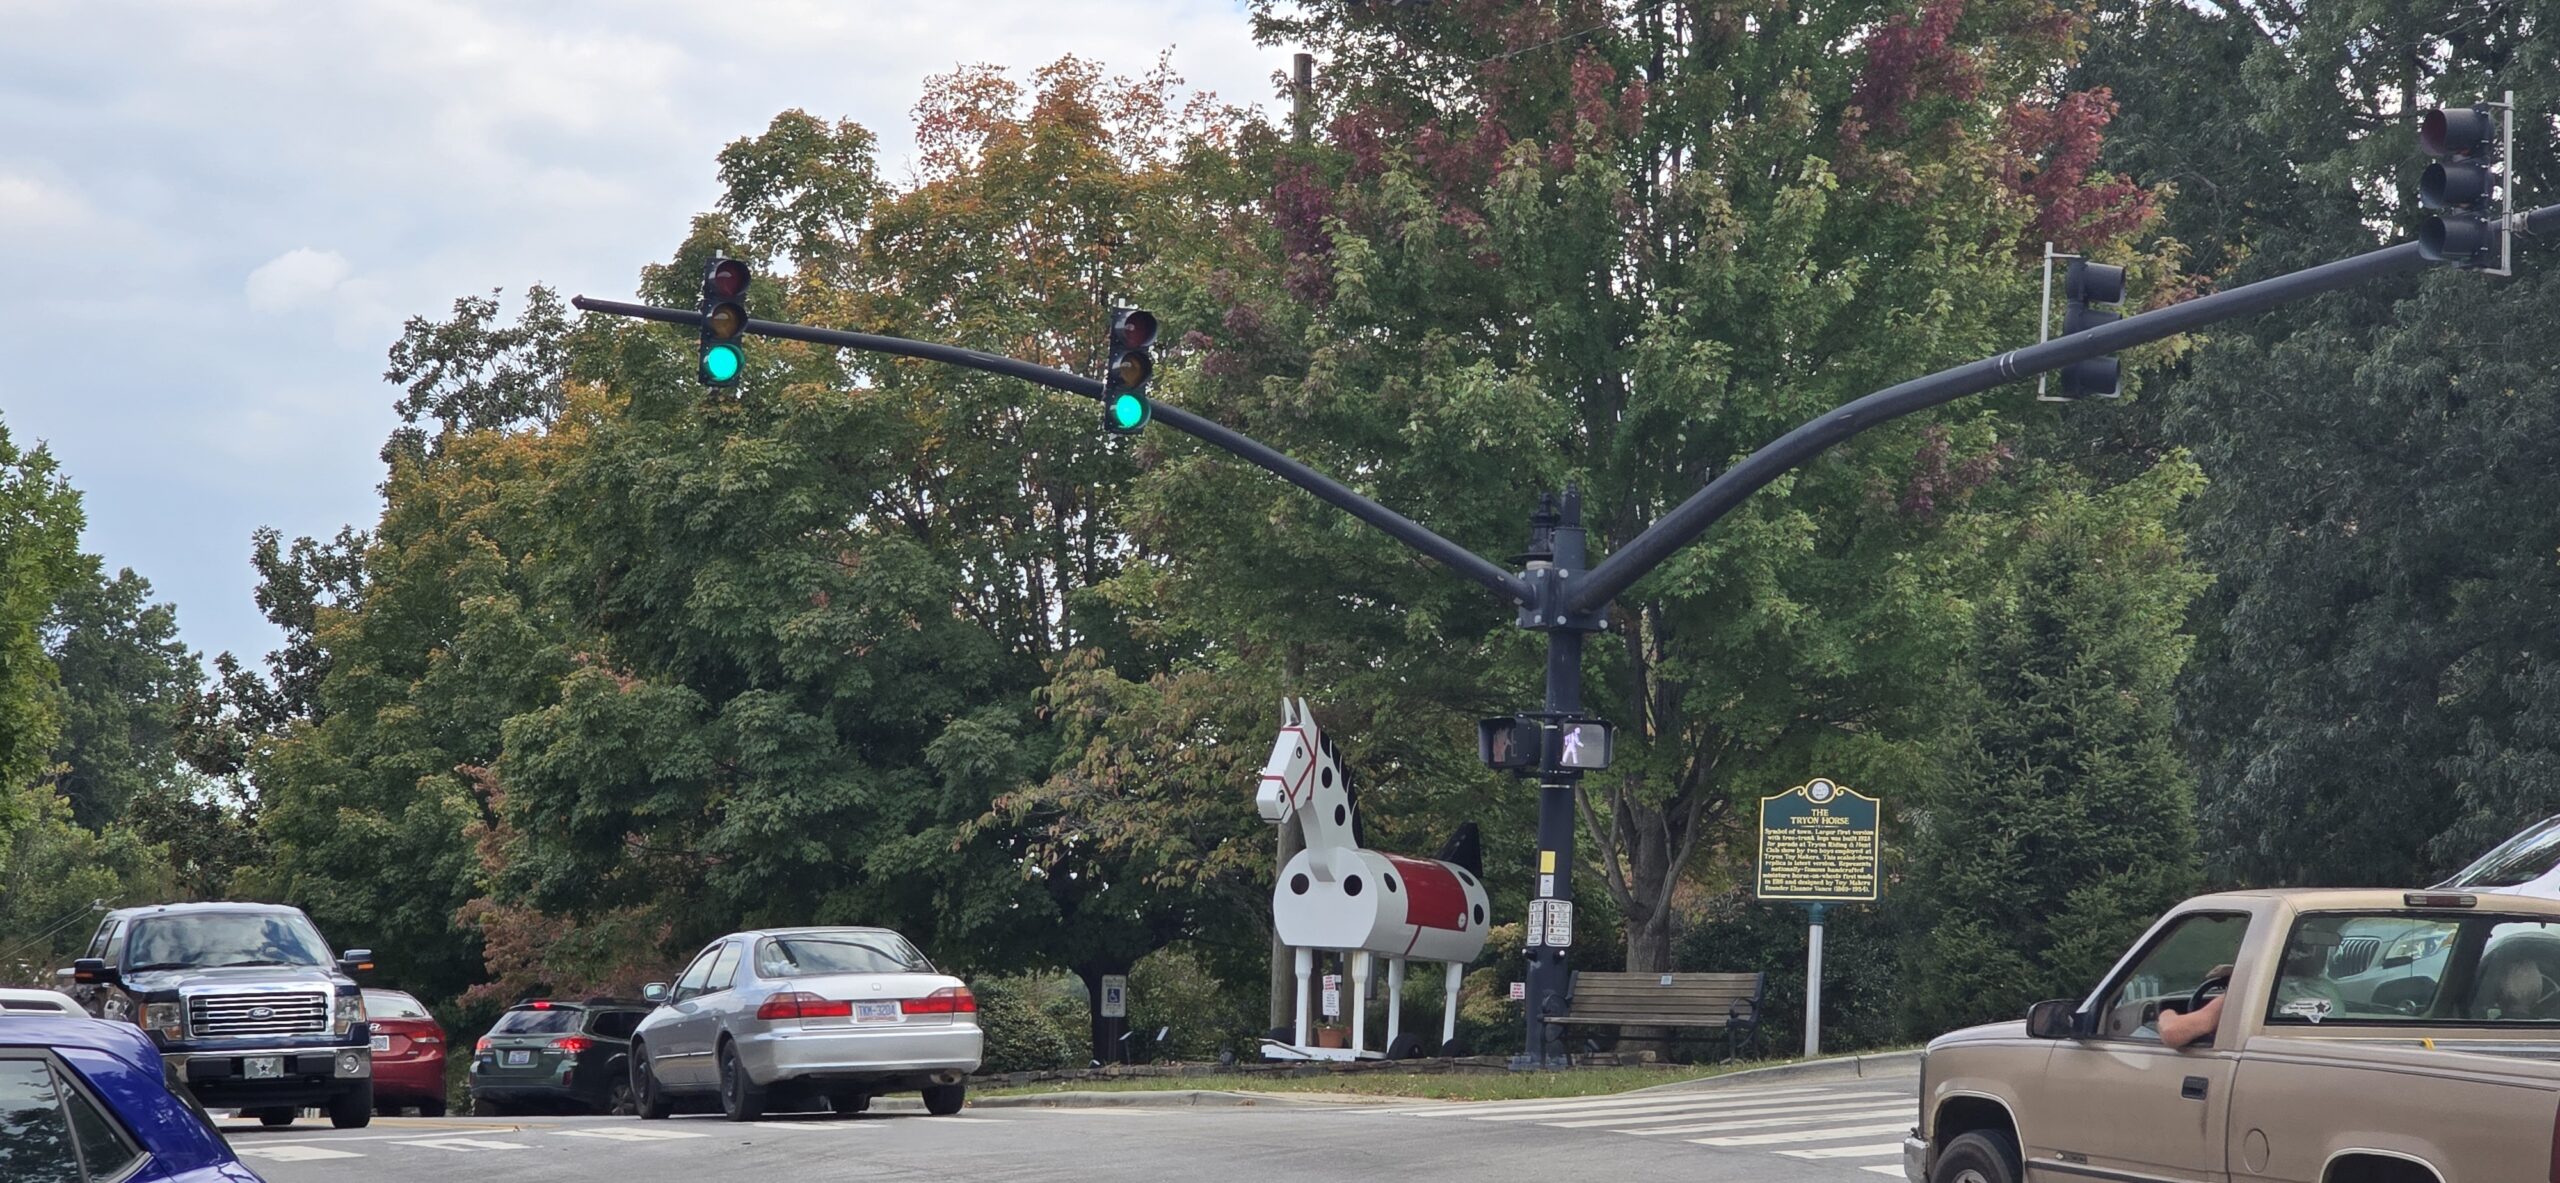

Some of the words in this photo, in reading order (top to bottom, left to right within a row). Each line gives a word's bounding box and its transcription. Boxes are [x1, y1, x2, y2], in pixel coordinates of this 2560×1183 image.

[1811, 808, 1829, 816] THE
[1790, 816, 1819, 824] TRYON
[1822, 816, 1850, 824] HORSE
